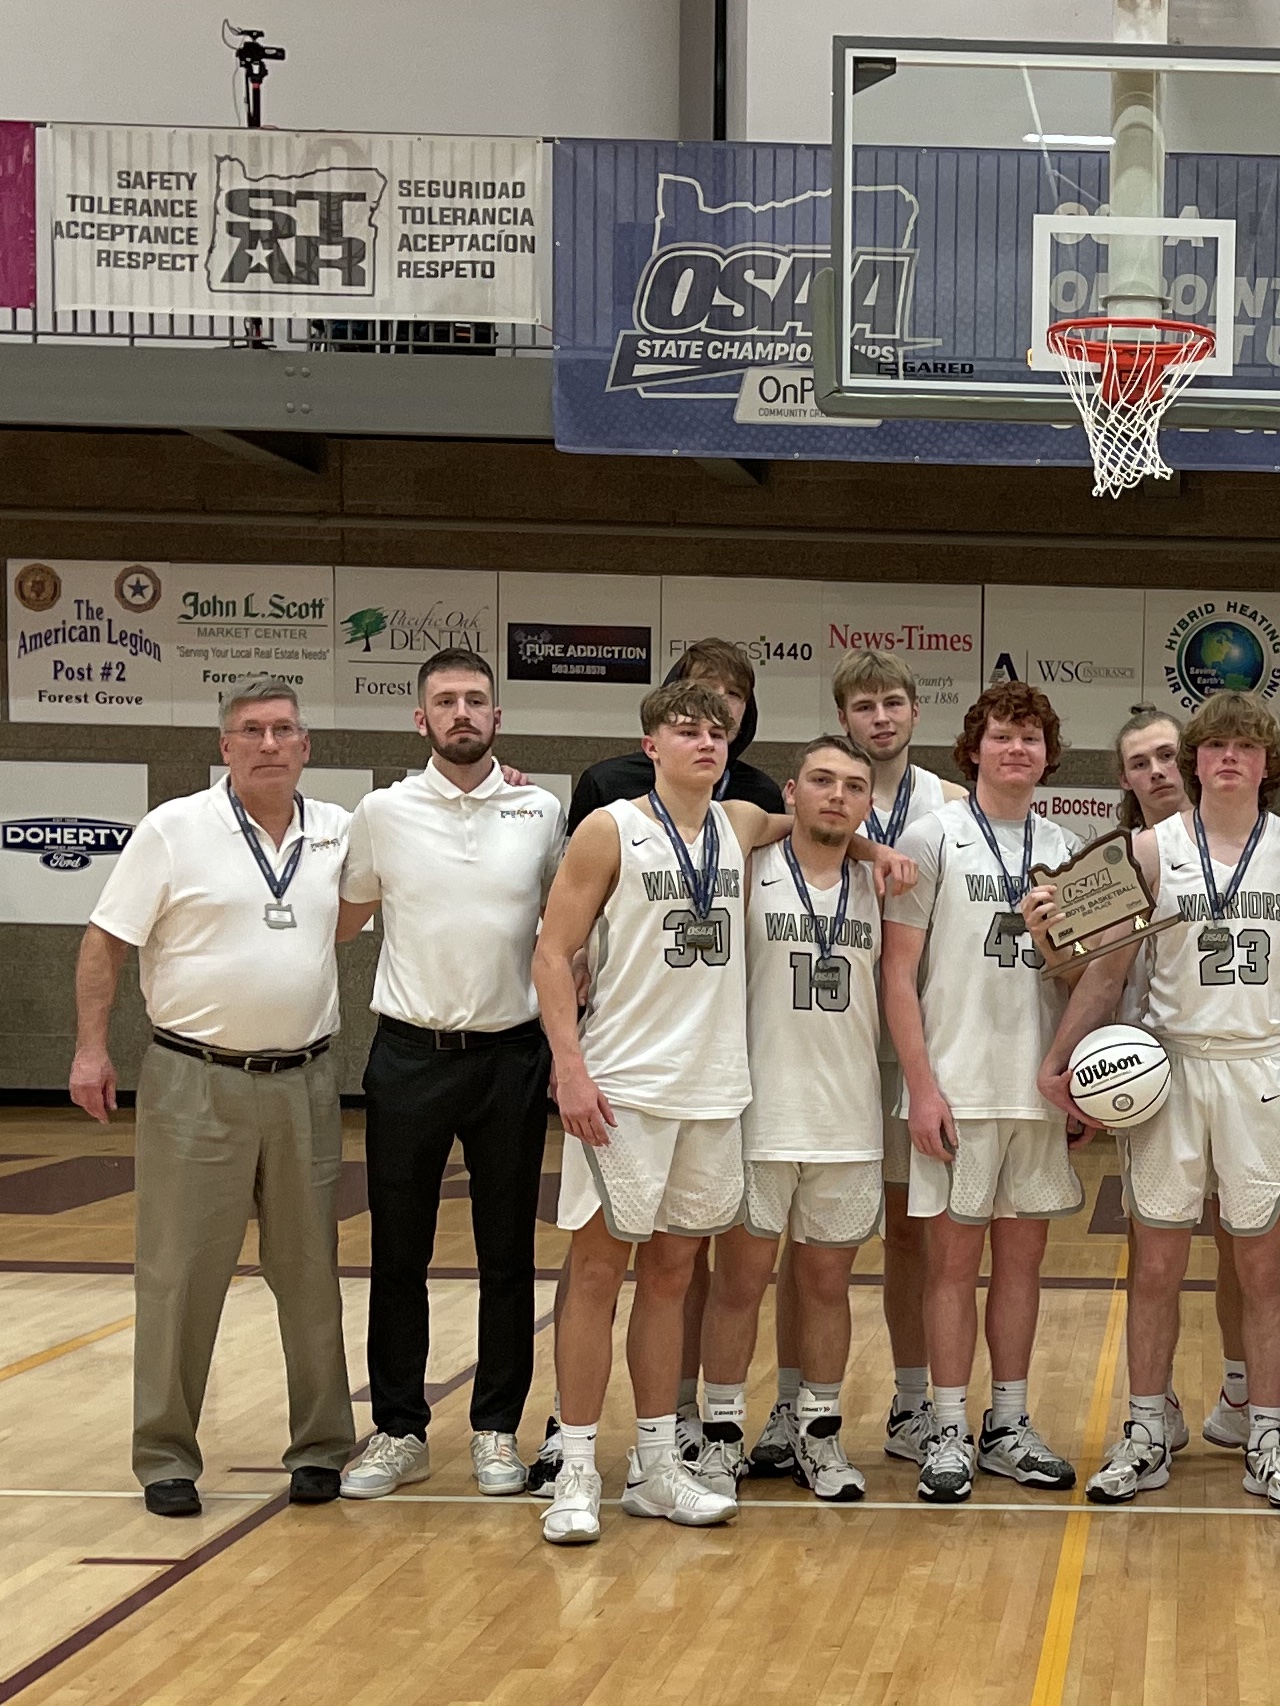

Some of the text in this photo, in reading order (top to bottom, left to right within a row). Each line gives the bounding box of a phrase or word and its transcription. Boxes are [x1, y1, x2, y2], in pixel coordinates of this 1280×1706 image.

[116, 170, 198, 191] SAFETY
[397, 179, 526, 200] SEGURIDAD
[66, 194, 199, 219] TOLERANCE
[397, 206, 535, 227] TOLERANCIA
[52, 220, 199, 246] ACCEPTANCE
[96, 249, 199, 273] RESPECT
[397, 260, 496, 280] RESPETO
[636, 339, 702, 359] STATE
[902, 362, 975, 375] GARED
[758, 408, 807, 418] COMMUNITY
[74, 599, 104, 621] The
[177, 591, 237, 621] John
[267, 594, 326, 620] Scott
[389, 601, 490, 637] Pacific Oak
[1164, 602, 1216, 651] HYBRID
[17, 618, 162, 663] American Legion
[197, 627, 308, 640] MARKET CENTER
[390, 628, 489, 654] DENTAL
[828, 624, 973, 652] News-Times
[211, 647, 228, 659] Your
[230, 648, 251, 660] Local
[254, 648, 273, 660] Real
[274, 648, 300, 660] Estate
[526, 643, 647, 660] PURE ADDICTION
[53, 660, 127, 683] Post #2
[1036, 659, 1094, 684] WSC
[1163, 665, 1182, 695] AIR
[354, 676, 413, 696] Forest
[38, 689, 144, 706] Forest Grove
[934, 691, 960, 704] 1886
[1052, 797, 1113, 819] Booster
[6, 826, 129, 845] DOHERTY
[49, 852, 82, 868] Ford
[1062, 868, 1113, 903] OSAA
[1065, 905, 1086, 918] BOYS
[1087, 884, 1138, 908] BASKETBALL
[663, 907, 731, 968] 30
[686, 925, 714, 936] OSAA
[1197, 928, 1271, 986] 23
[1076, 1054, 1143, 1087] Wilson
